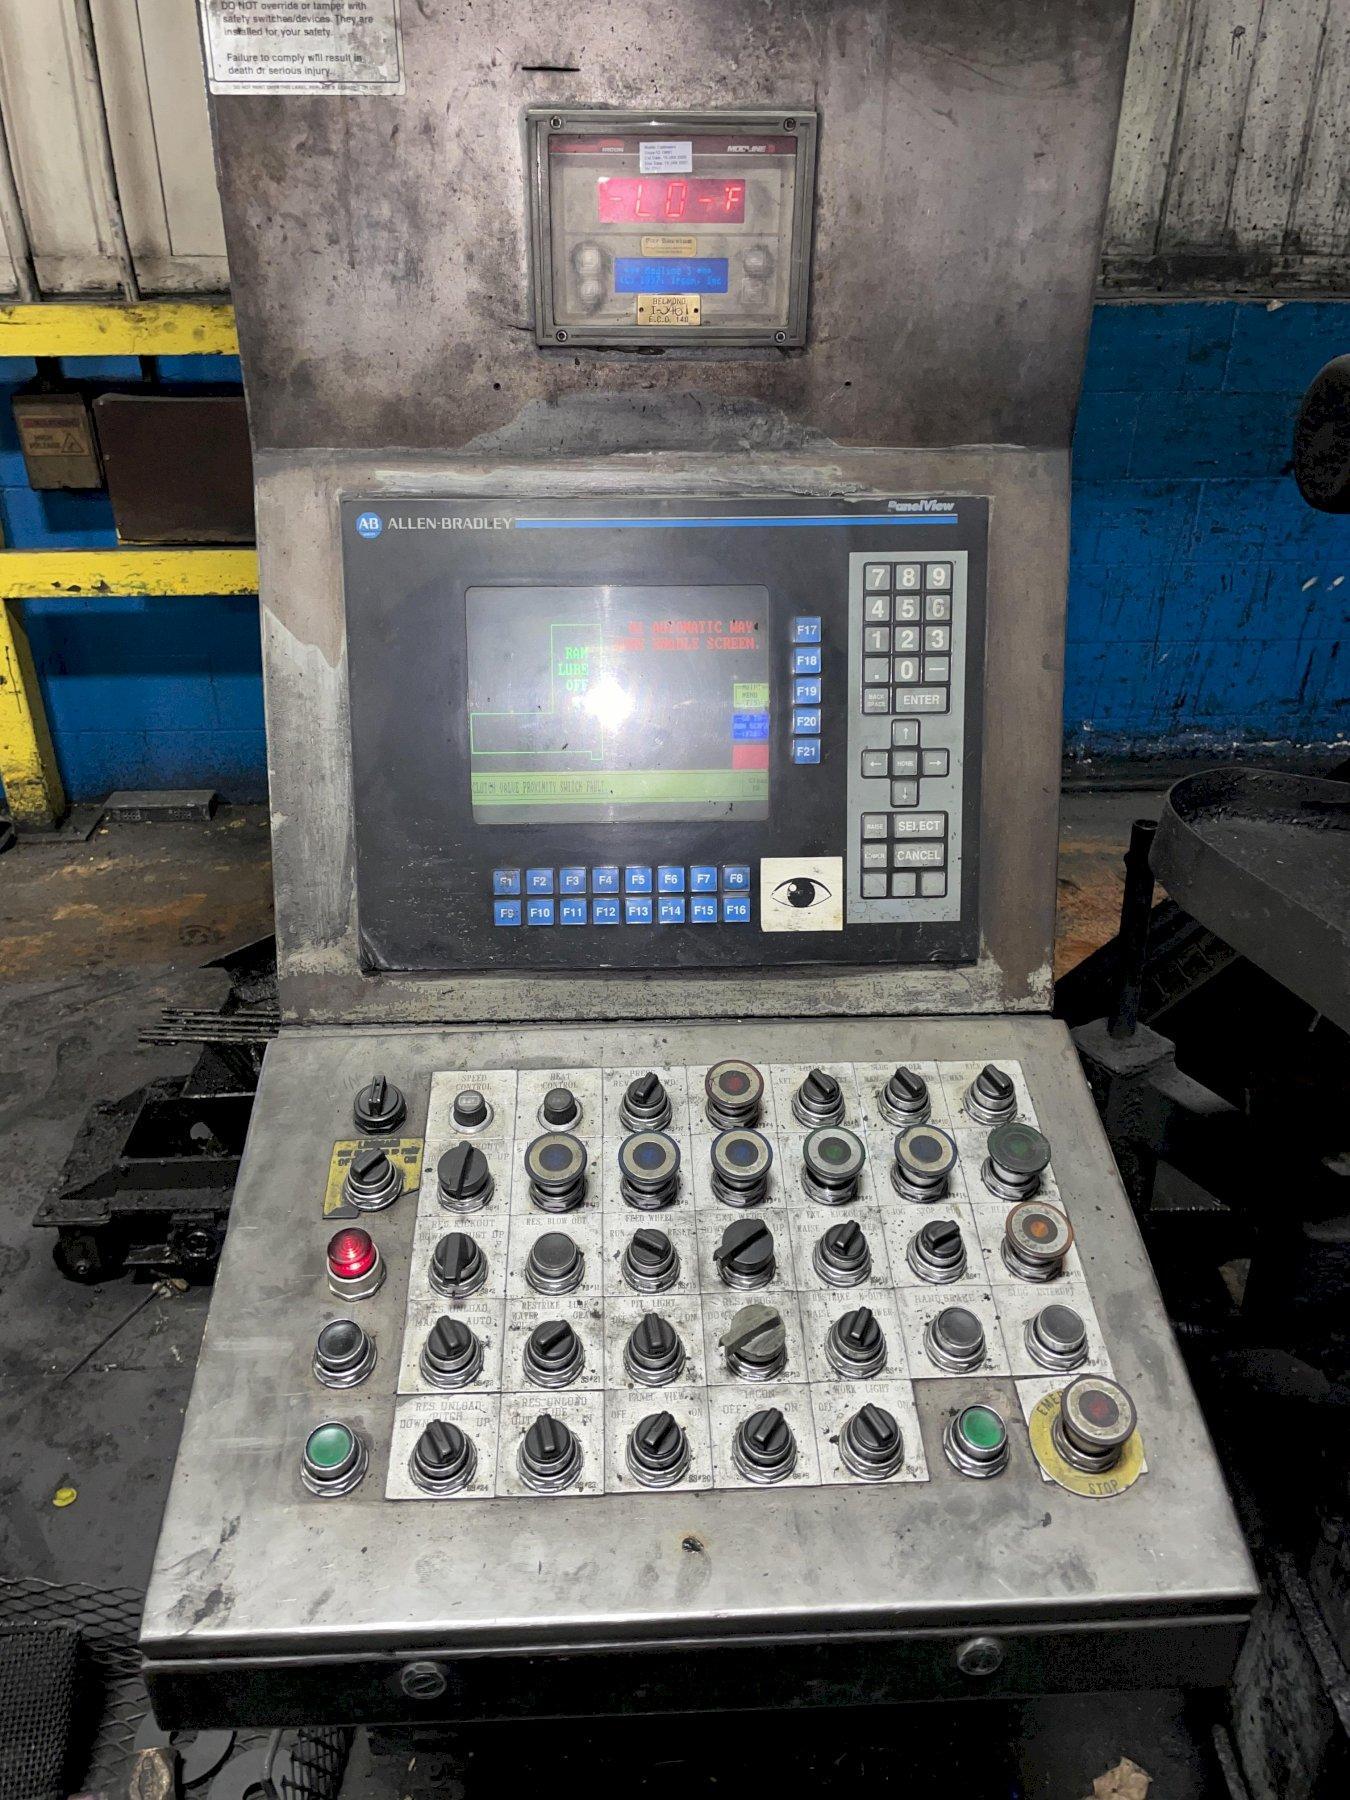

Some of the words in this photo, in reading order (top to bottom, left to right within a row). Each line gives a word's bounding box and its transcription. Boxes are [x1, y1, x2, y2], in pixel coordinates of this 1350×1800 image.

[221, 1, 235, 11] DO
[238, 1, 257, 11] NOT
[260, 1, 299, 11] override
[301, 2, 311, 11] or
[313, 1, 345, 13] tamper
[347, 1, 367, 11] with
[223, 14, 251, 25] safety
[334, 14, 356, 26] They
[359, 15, 374, 24] are
[224, 27, 263, 37] installed
[265, 27, 278, 37] for
[280, 28, 301, 38] your
[304, 27, 333, 38] safety.
[226, 53, 259, 63] Failure
[260, 53, 270, 63] to
[271, 54, 305, 66] comply
[307, 53, 324, 63] will
[325, 53, 351, 63] result
[353, 54, 363, 63] in
[228, 66, 254, 75] death
[256, 67, 265, 75] or
[268, 66, 302, 75] serious
[887, 500, 956, 512] PanelView
[387, 517, 514, 530] ALLEN-BRADLEY
[872, 568, 886, 588] 7
[902, 567, 915, 587] 8
[932, 567, 946, 587] 9
[871, 599, 885, 618] 4
[901, 599, 914, 618] 5
[932, 598, 945, 617] 6
[797, 625, 818, 635] F17
[871, 630, 881, 649] 1
[901, 630, 914, 649] 2
[931, 629, 944, 649] 3
[797, 656, 817, 666] F18
[900, 660, 914, 679] 0
[796, 686, 817, 696] F19
[903, 694, 940, 706] ENTER
[796, 716, 817, 727] F20
[797, 747, 816, 757] F21
[522, 781, 557, 794] PROXIMITY
[898, 820, 941, 832] SELECT
[897, 850, 941, 861] CANCEL
[533, 876, 547, 886] F2
[566, 876, 580, 886] F3
[598, 875, 612, 885] F4
[631, 875, 645, 885] F5
[664, 874, 678, 884] F6
[697, 874, 711, 884] F7
[729, 873, 743, 883] F8
[530, 908, 550, 918] F10
[563, 907, 582, 917] F11
[596, 907, 616, 917] F12
[629, 906, 649, 916] F13
[662, 906, 681, 916] F14
[694, 906, 713, 916] F15
[726, 905, 746, 915] F16
[460, 1074, 488, 1082] SPEED
[549, 1072, 571, 1081] HEAT
[455, 1083, 493, 1091] CONTROL
[547, 1217, 568, 1225] BLOW
[624, 1214, 646, 1222] FEED
[648, 1214, 674, 1222] WHEEL
[609, 1229, 626, 1237] RUN
[652, 1298, 676, 1308] LIGHT
[914, 1294, 941, 1303] HAND
[449, 1303, 488, 1313] UNLOAD
[466, 1316, 492, 1326] AUTO
[865, 1383, 890, 1394] LIGHT
[546, 1395, 588, 1406] UNLOAD
[664, 1391, 686, 1401] VIEW
[440, 1400, 484, 1411] UNLOAD
[722, 1404, 741, 1415] OFF
[785, 1402, 799, 1412] ON
[818, 1401, 833, 1412] OFF
[610, 1409, 627, 1419] OFF
[476, 1417, 491, 1427] UP
[1087, 1479, 1119, 1496] STOP
